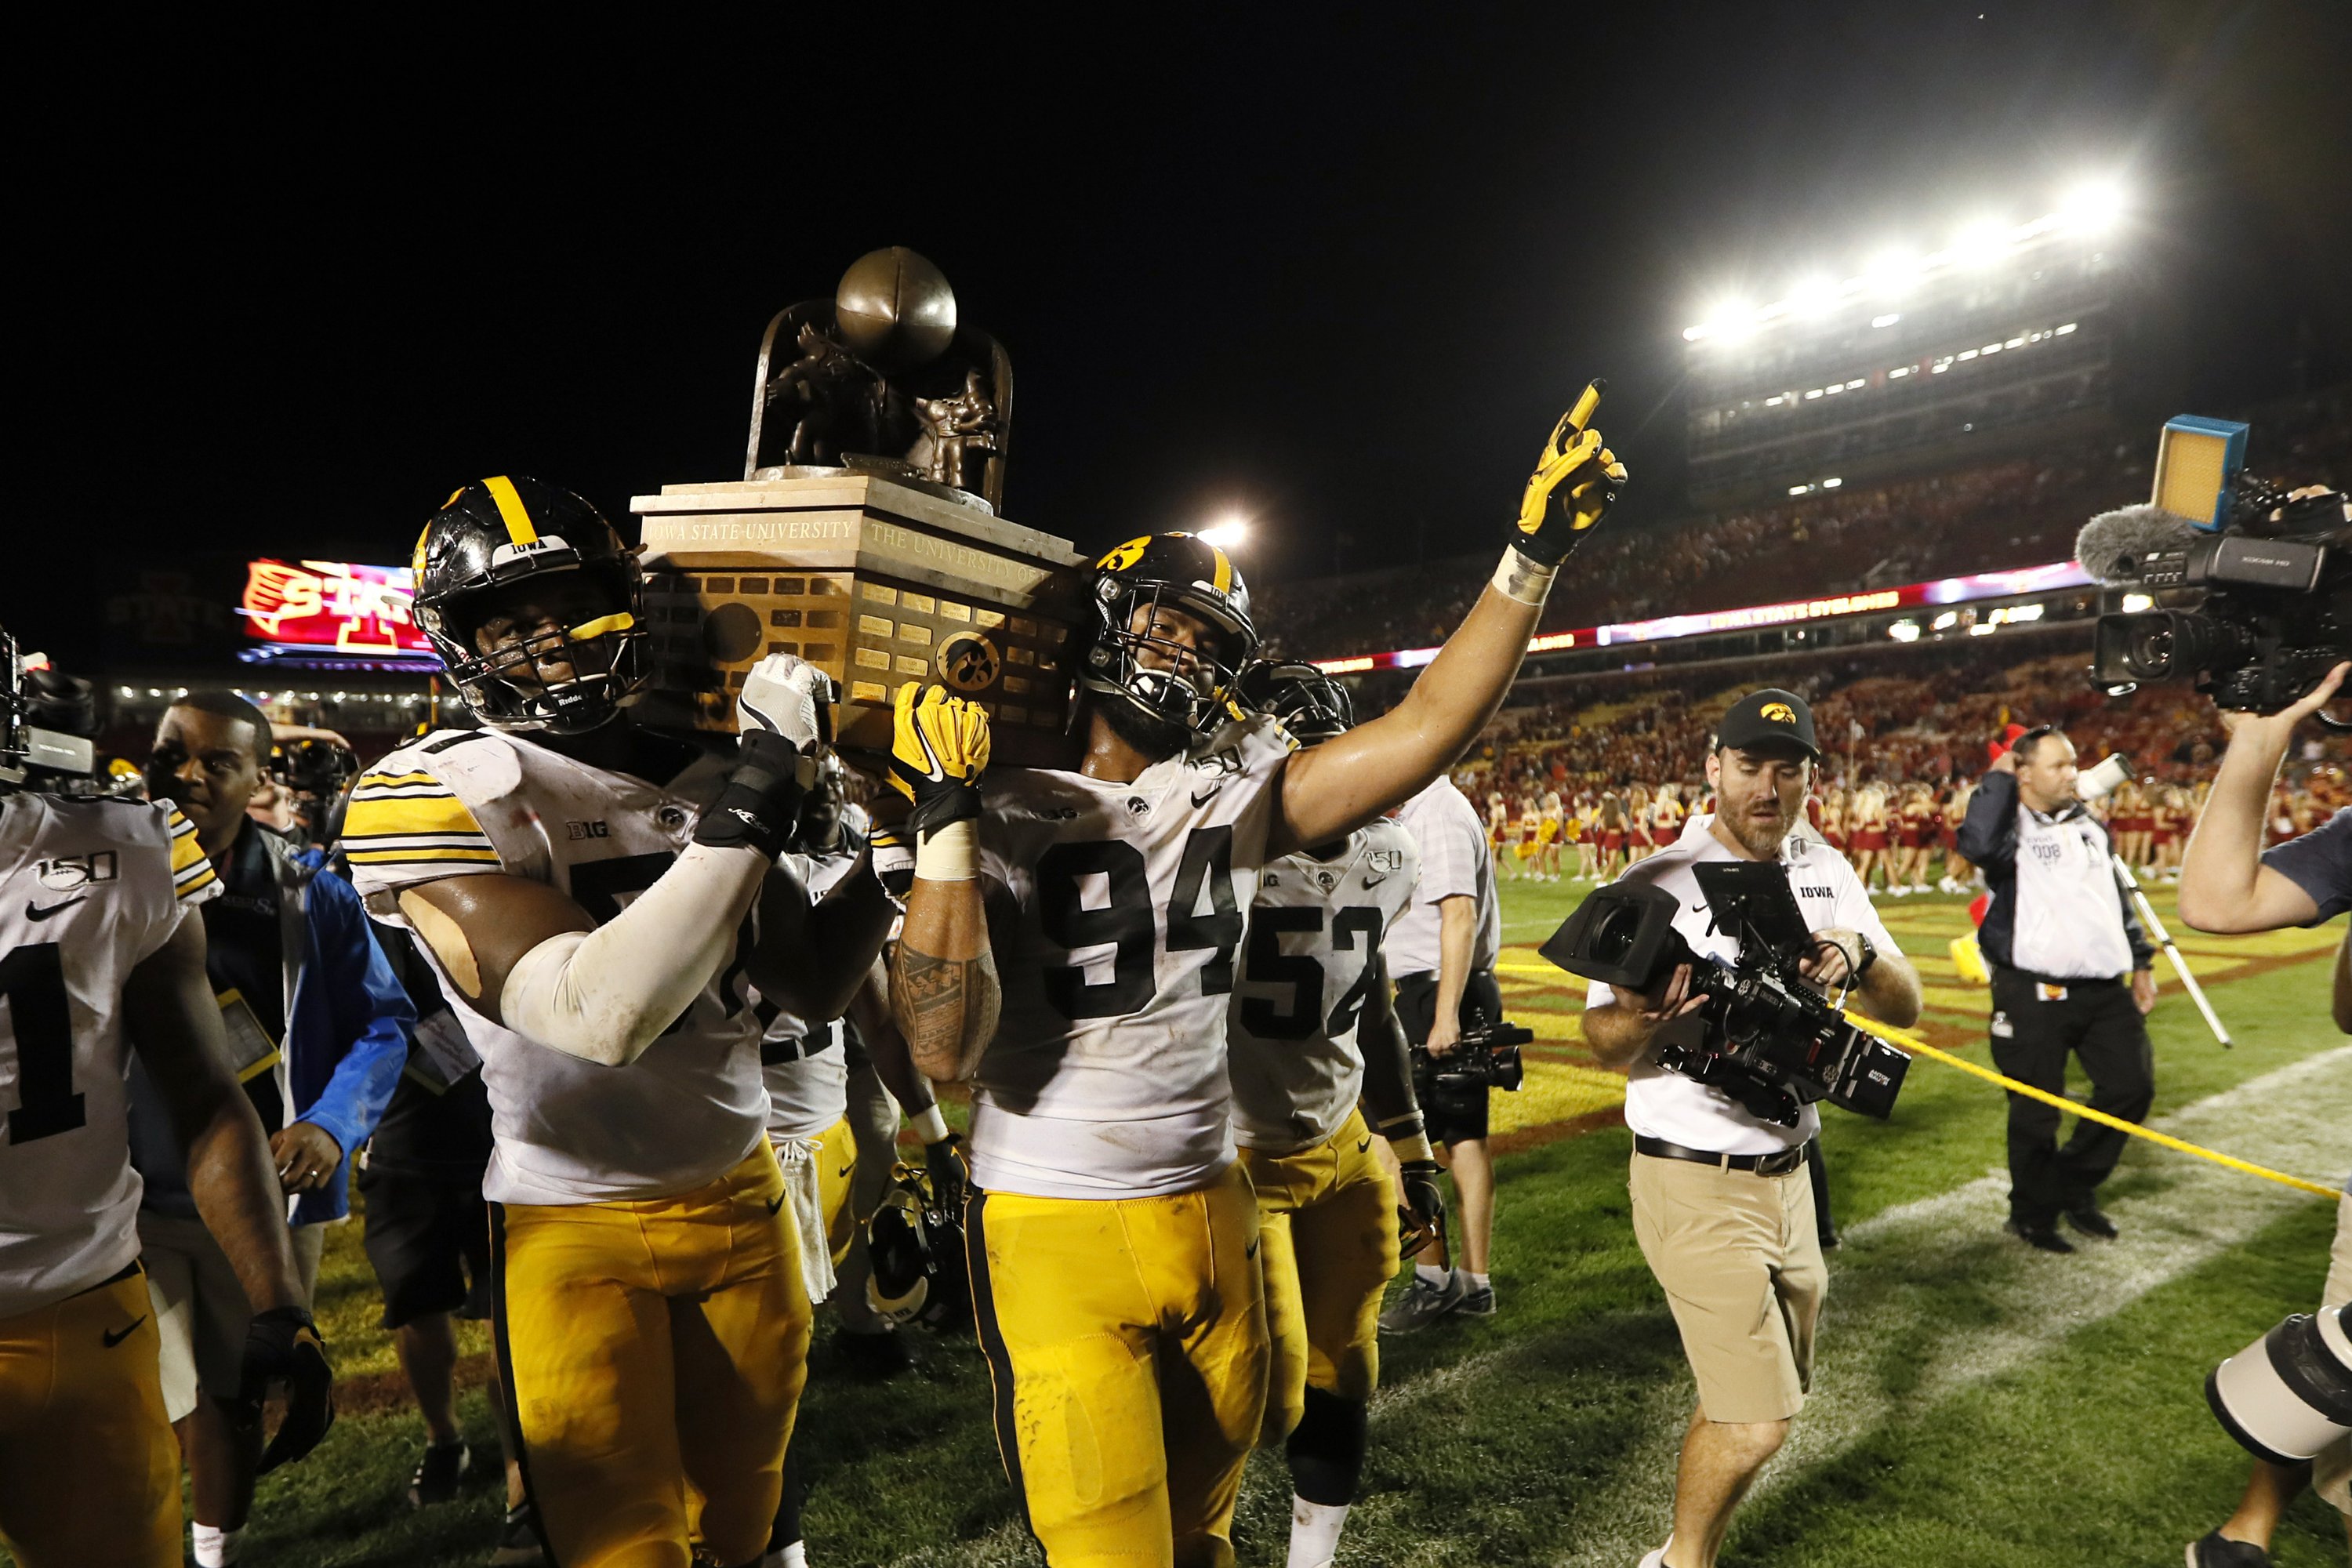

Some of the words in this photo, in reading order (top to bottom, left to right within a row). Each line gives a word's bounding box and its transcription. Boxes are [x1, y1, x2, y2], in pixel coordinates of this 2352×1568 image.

[648, 524, 686, 540] IOWA
[691, 522, 740, 541] STATE
[746, 520, 855, 540] UNIVERSITY
[871, 523, 907, 550] THE
[913, 535, 1014, 579] UNIVERSITY
[1017, 565, 1036, 584] OF
[1036, 824, 1243, 1020] 94
[1800, 886, 1835, 899] IOWA
[1240, 906, 1385, 1041] 52
